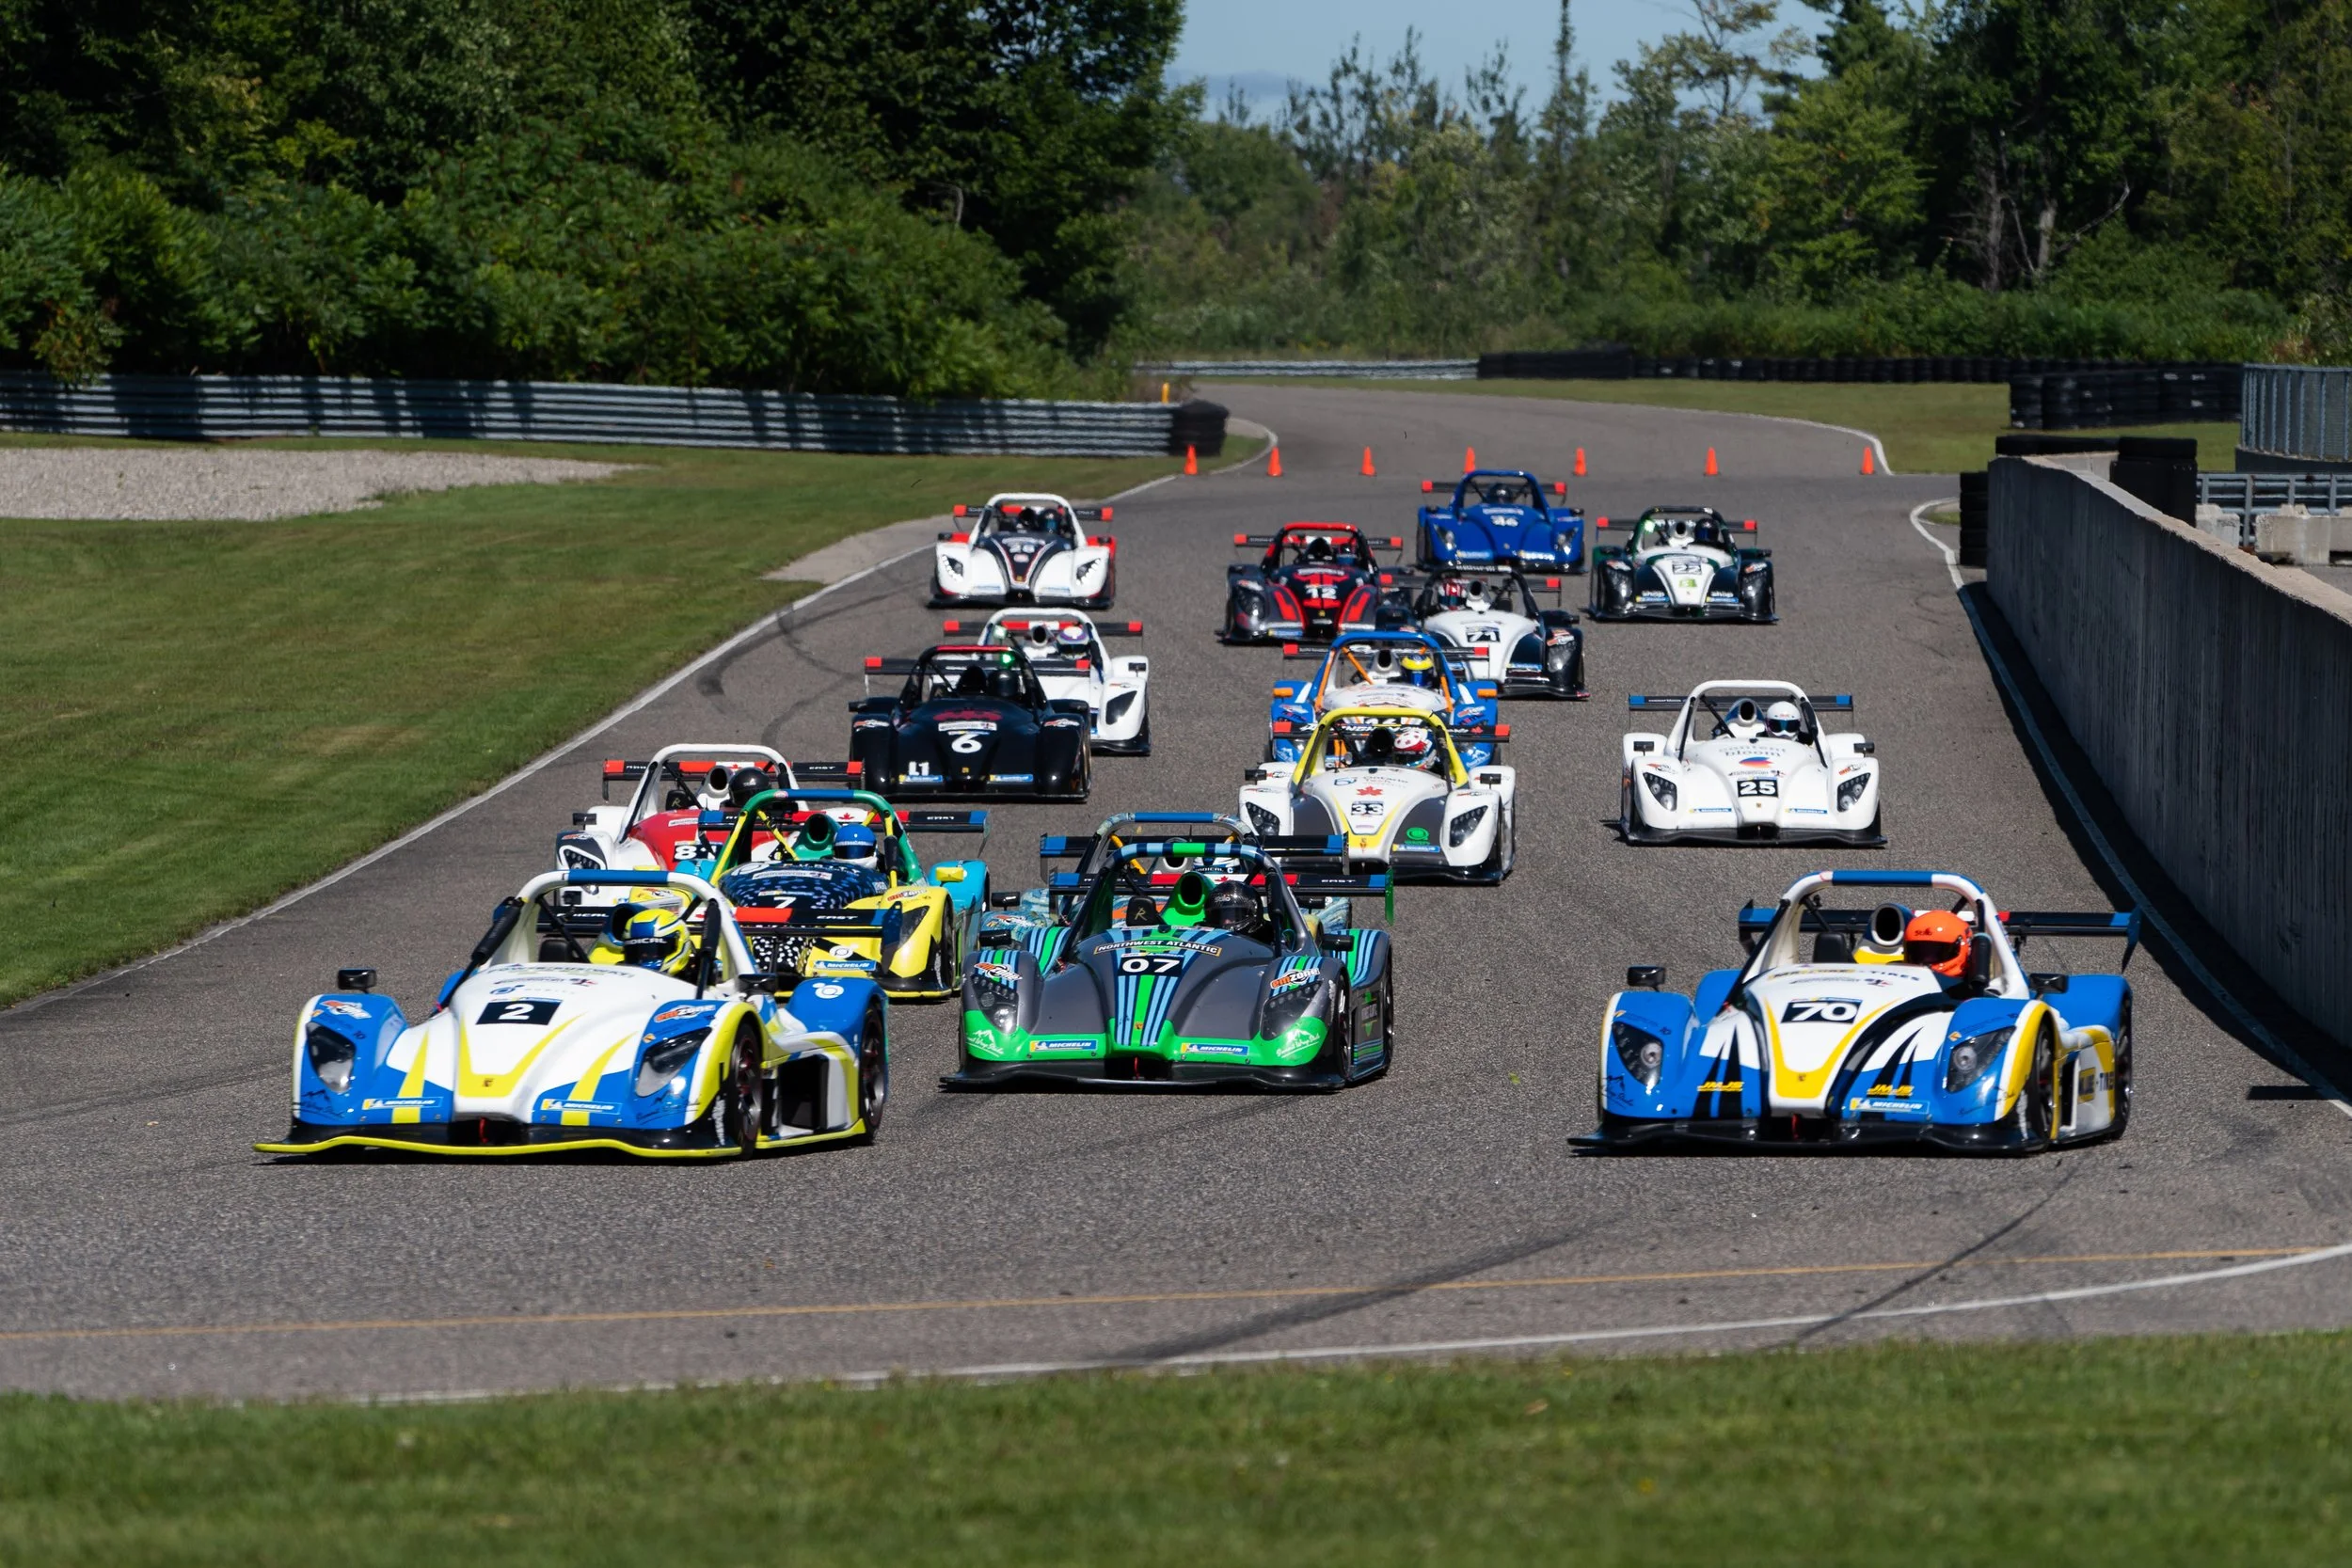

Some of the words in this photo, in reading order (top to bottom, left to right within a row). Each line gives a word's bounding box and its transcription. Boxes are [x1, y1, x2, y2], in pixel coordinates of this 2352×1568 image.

[1468, 631, 1497, 641] 71
[951, 733, 982, 753] 6
[909, 761, 930, 776] L1
[1740, 781, 1776, 796] 25
[1352, 802, 1383, 816] 33
[773, 896, 797, 909] 7
[1098, 940, 1164, 952] NORTHWEST
[1167, 940, 1217, 954] ATLANTIC
[1122, 958, 1181, 974] 07
[1270, 968, 1321, 989] emzone
[1870, 970, 1920, 981] TIRES
[498, 1003, 534, 1021] 2
[1791, 1002, 1858, 1022] 70
[1872, 1101, 1924, 1110] MICHELIN
